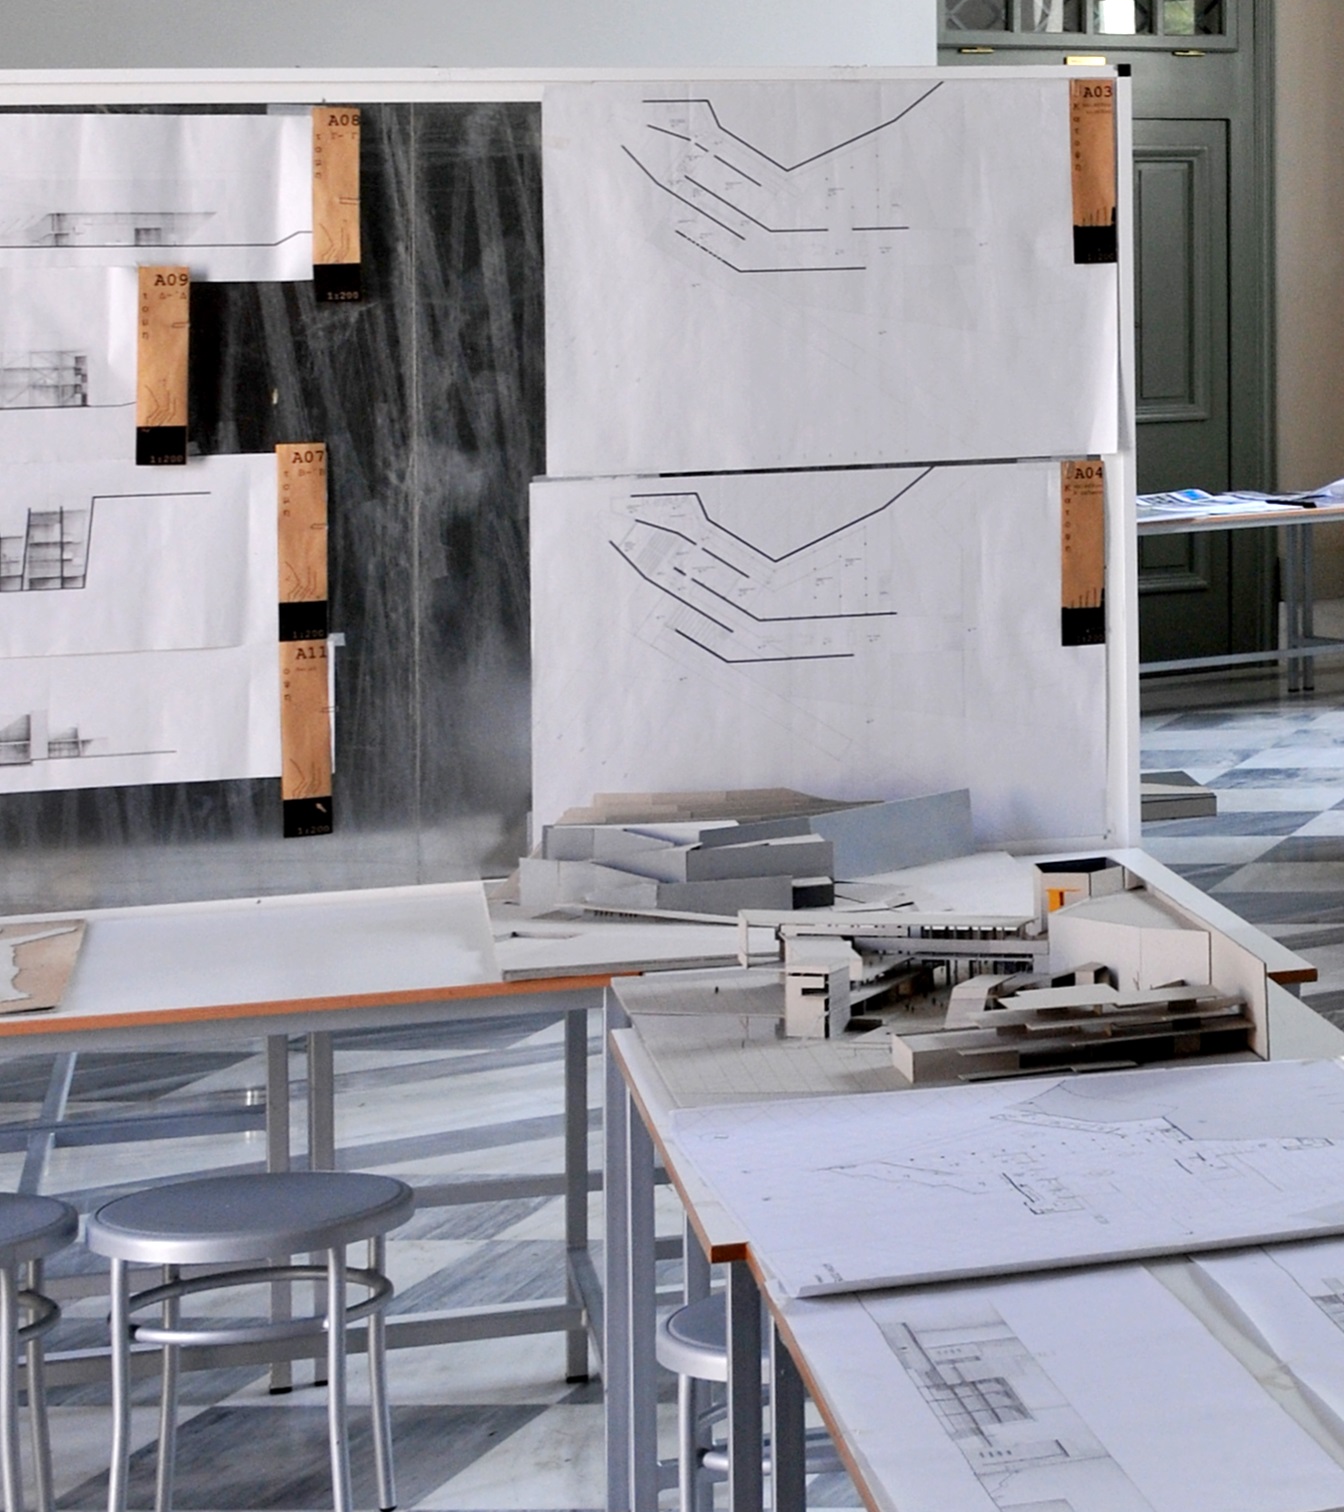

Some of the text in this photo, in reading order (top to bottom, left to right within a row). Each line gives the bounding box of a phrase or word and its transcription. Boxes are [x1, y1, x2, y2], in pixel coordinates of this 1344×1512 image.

[1083, 85, 1113, 98] A03
[327, 114, 361, 127] A08
[153, 273, 189, 287] A09
[327, 291, 359, 300] 1:200
[292, 450, 325, 464] A07
[1074, 466, 1103, 480] A04
[295, 645, 328, 660] A11
